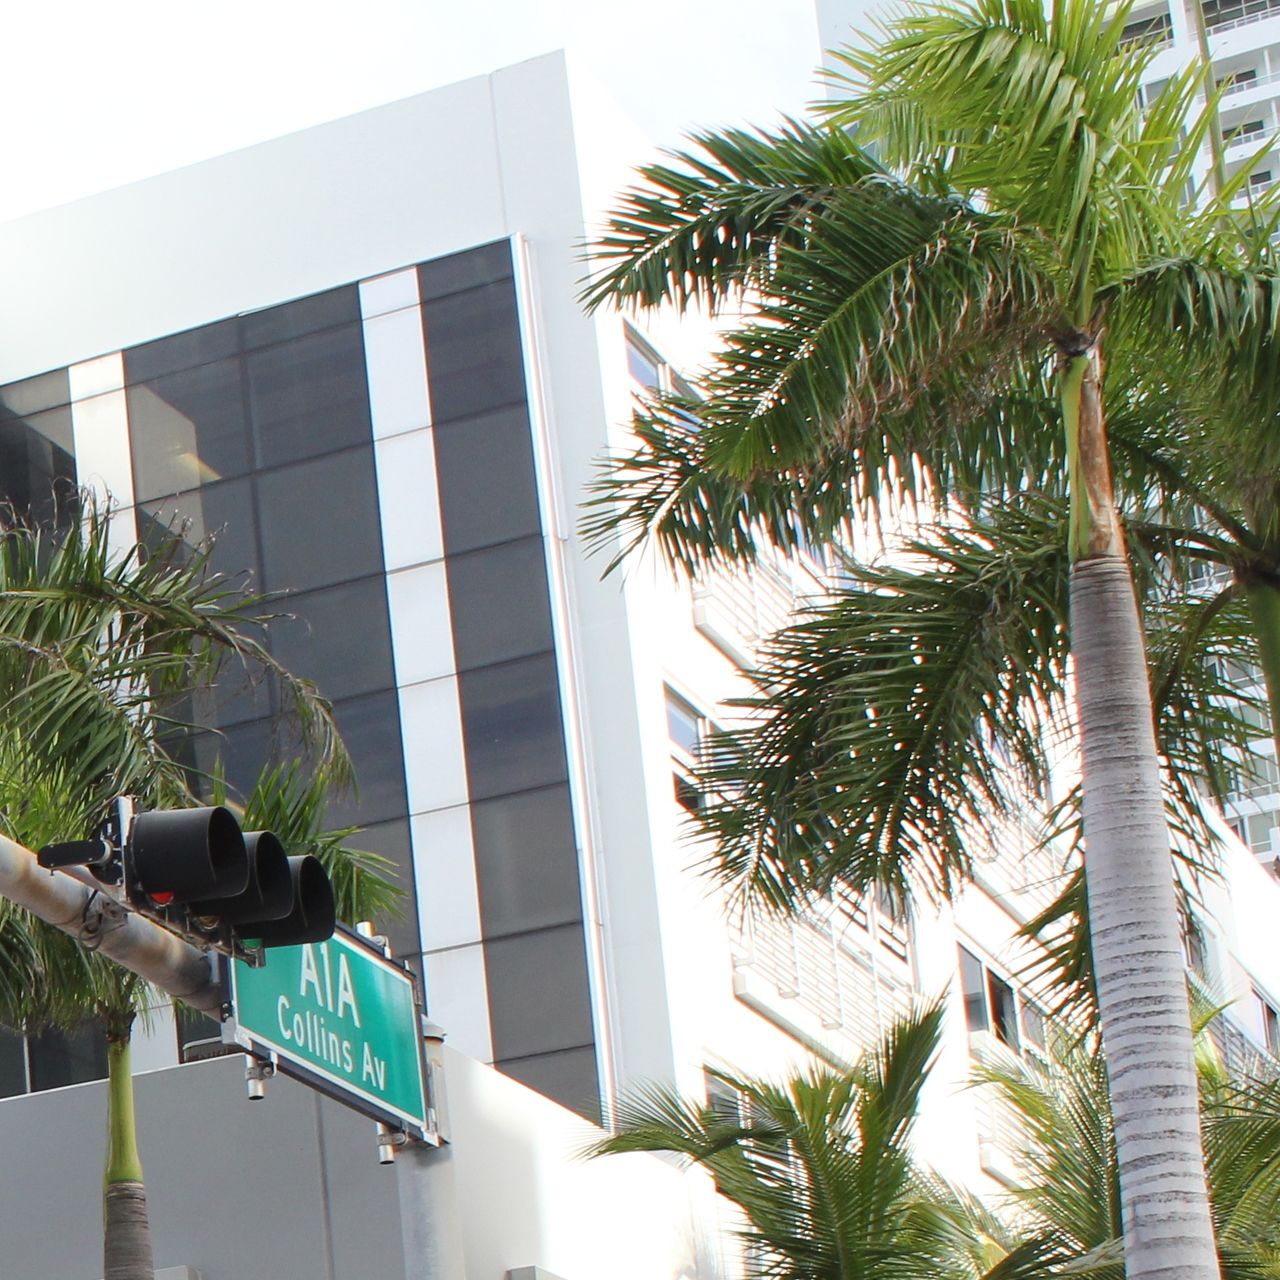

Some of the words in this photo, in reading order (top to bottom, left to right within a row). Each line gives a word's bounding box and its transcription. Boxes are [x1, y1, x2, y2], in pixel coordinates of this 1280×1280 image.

[299, 942, 361, 1028] A1A
[277, 995, 354, 1074] Collins
[362, 1041, 387, 1092] Av
